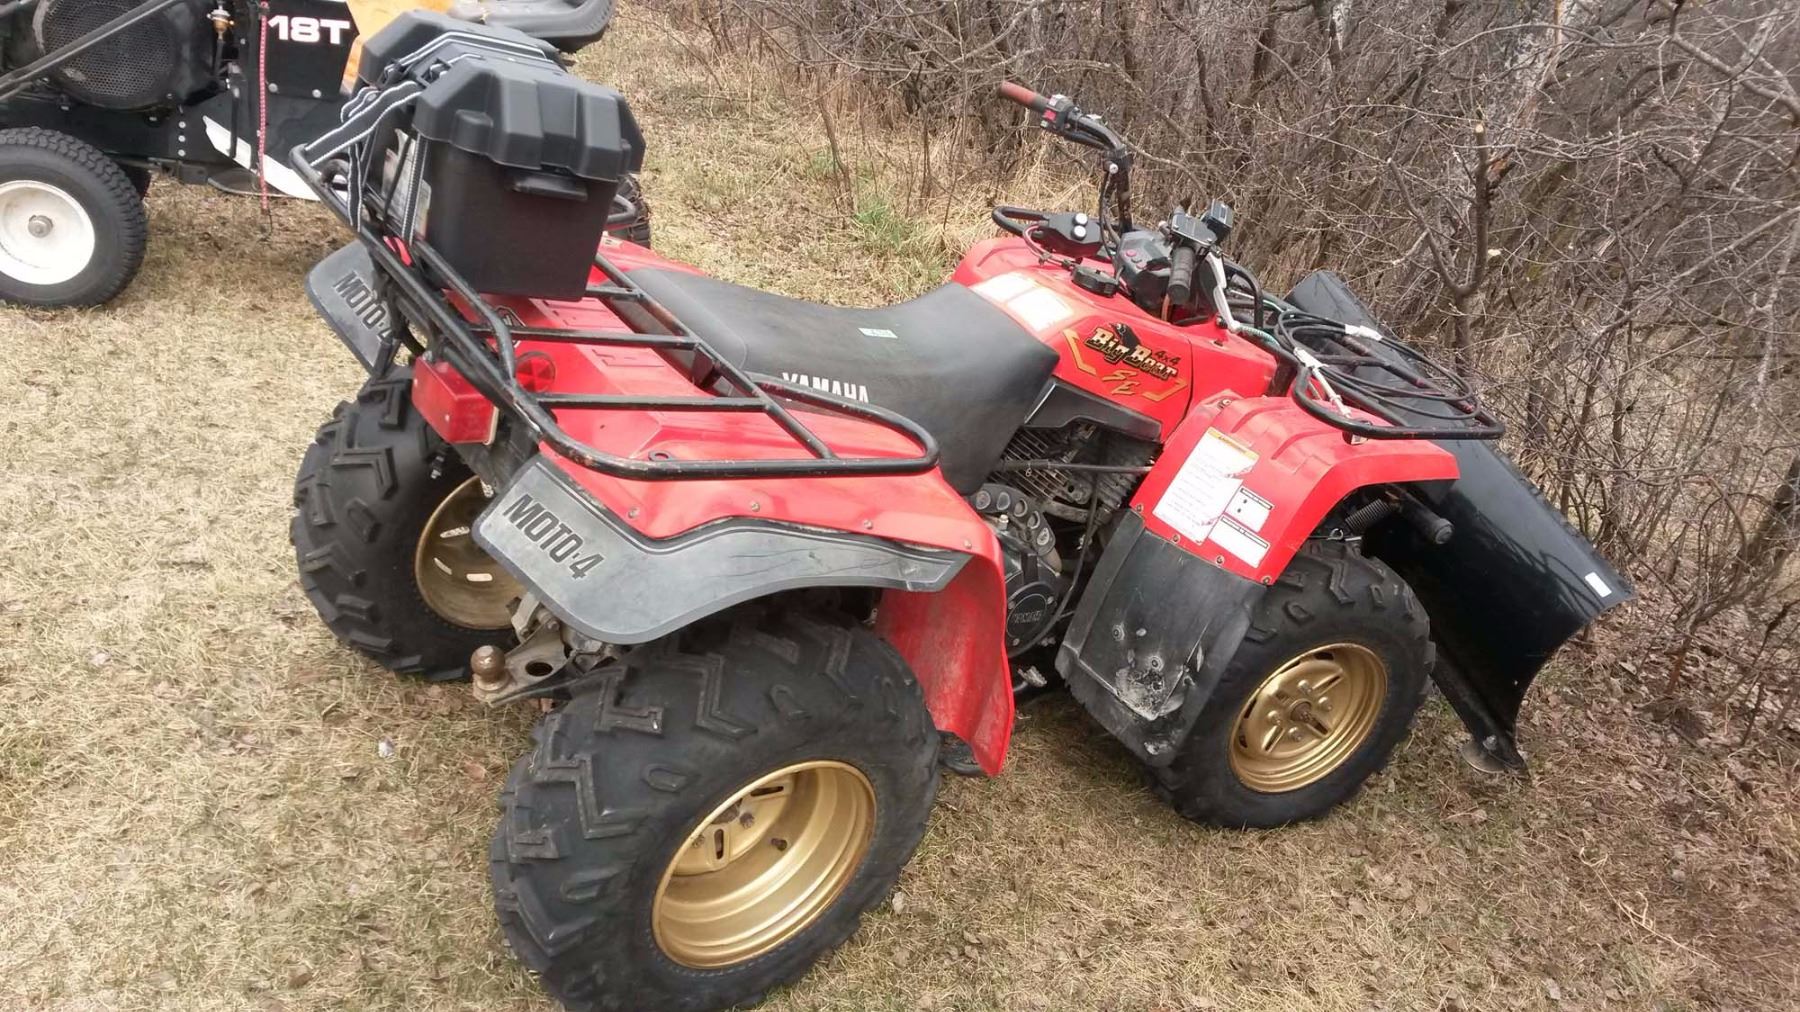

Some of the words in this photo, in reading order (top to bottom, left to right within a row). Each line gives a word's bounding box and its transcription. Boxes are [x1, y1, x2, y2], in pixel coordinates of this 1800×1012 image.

[267, 15, 351, 45] 18T
[1084, 326, 1131, 366] Big
[1123, 344, 1179, 381] Bear
[1154, 349, 1183, 366] 4x4
